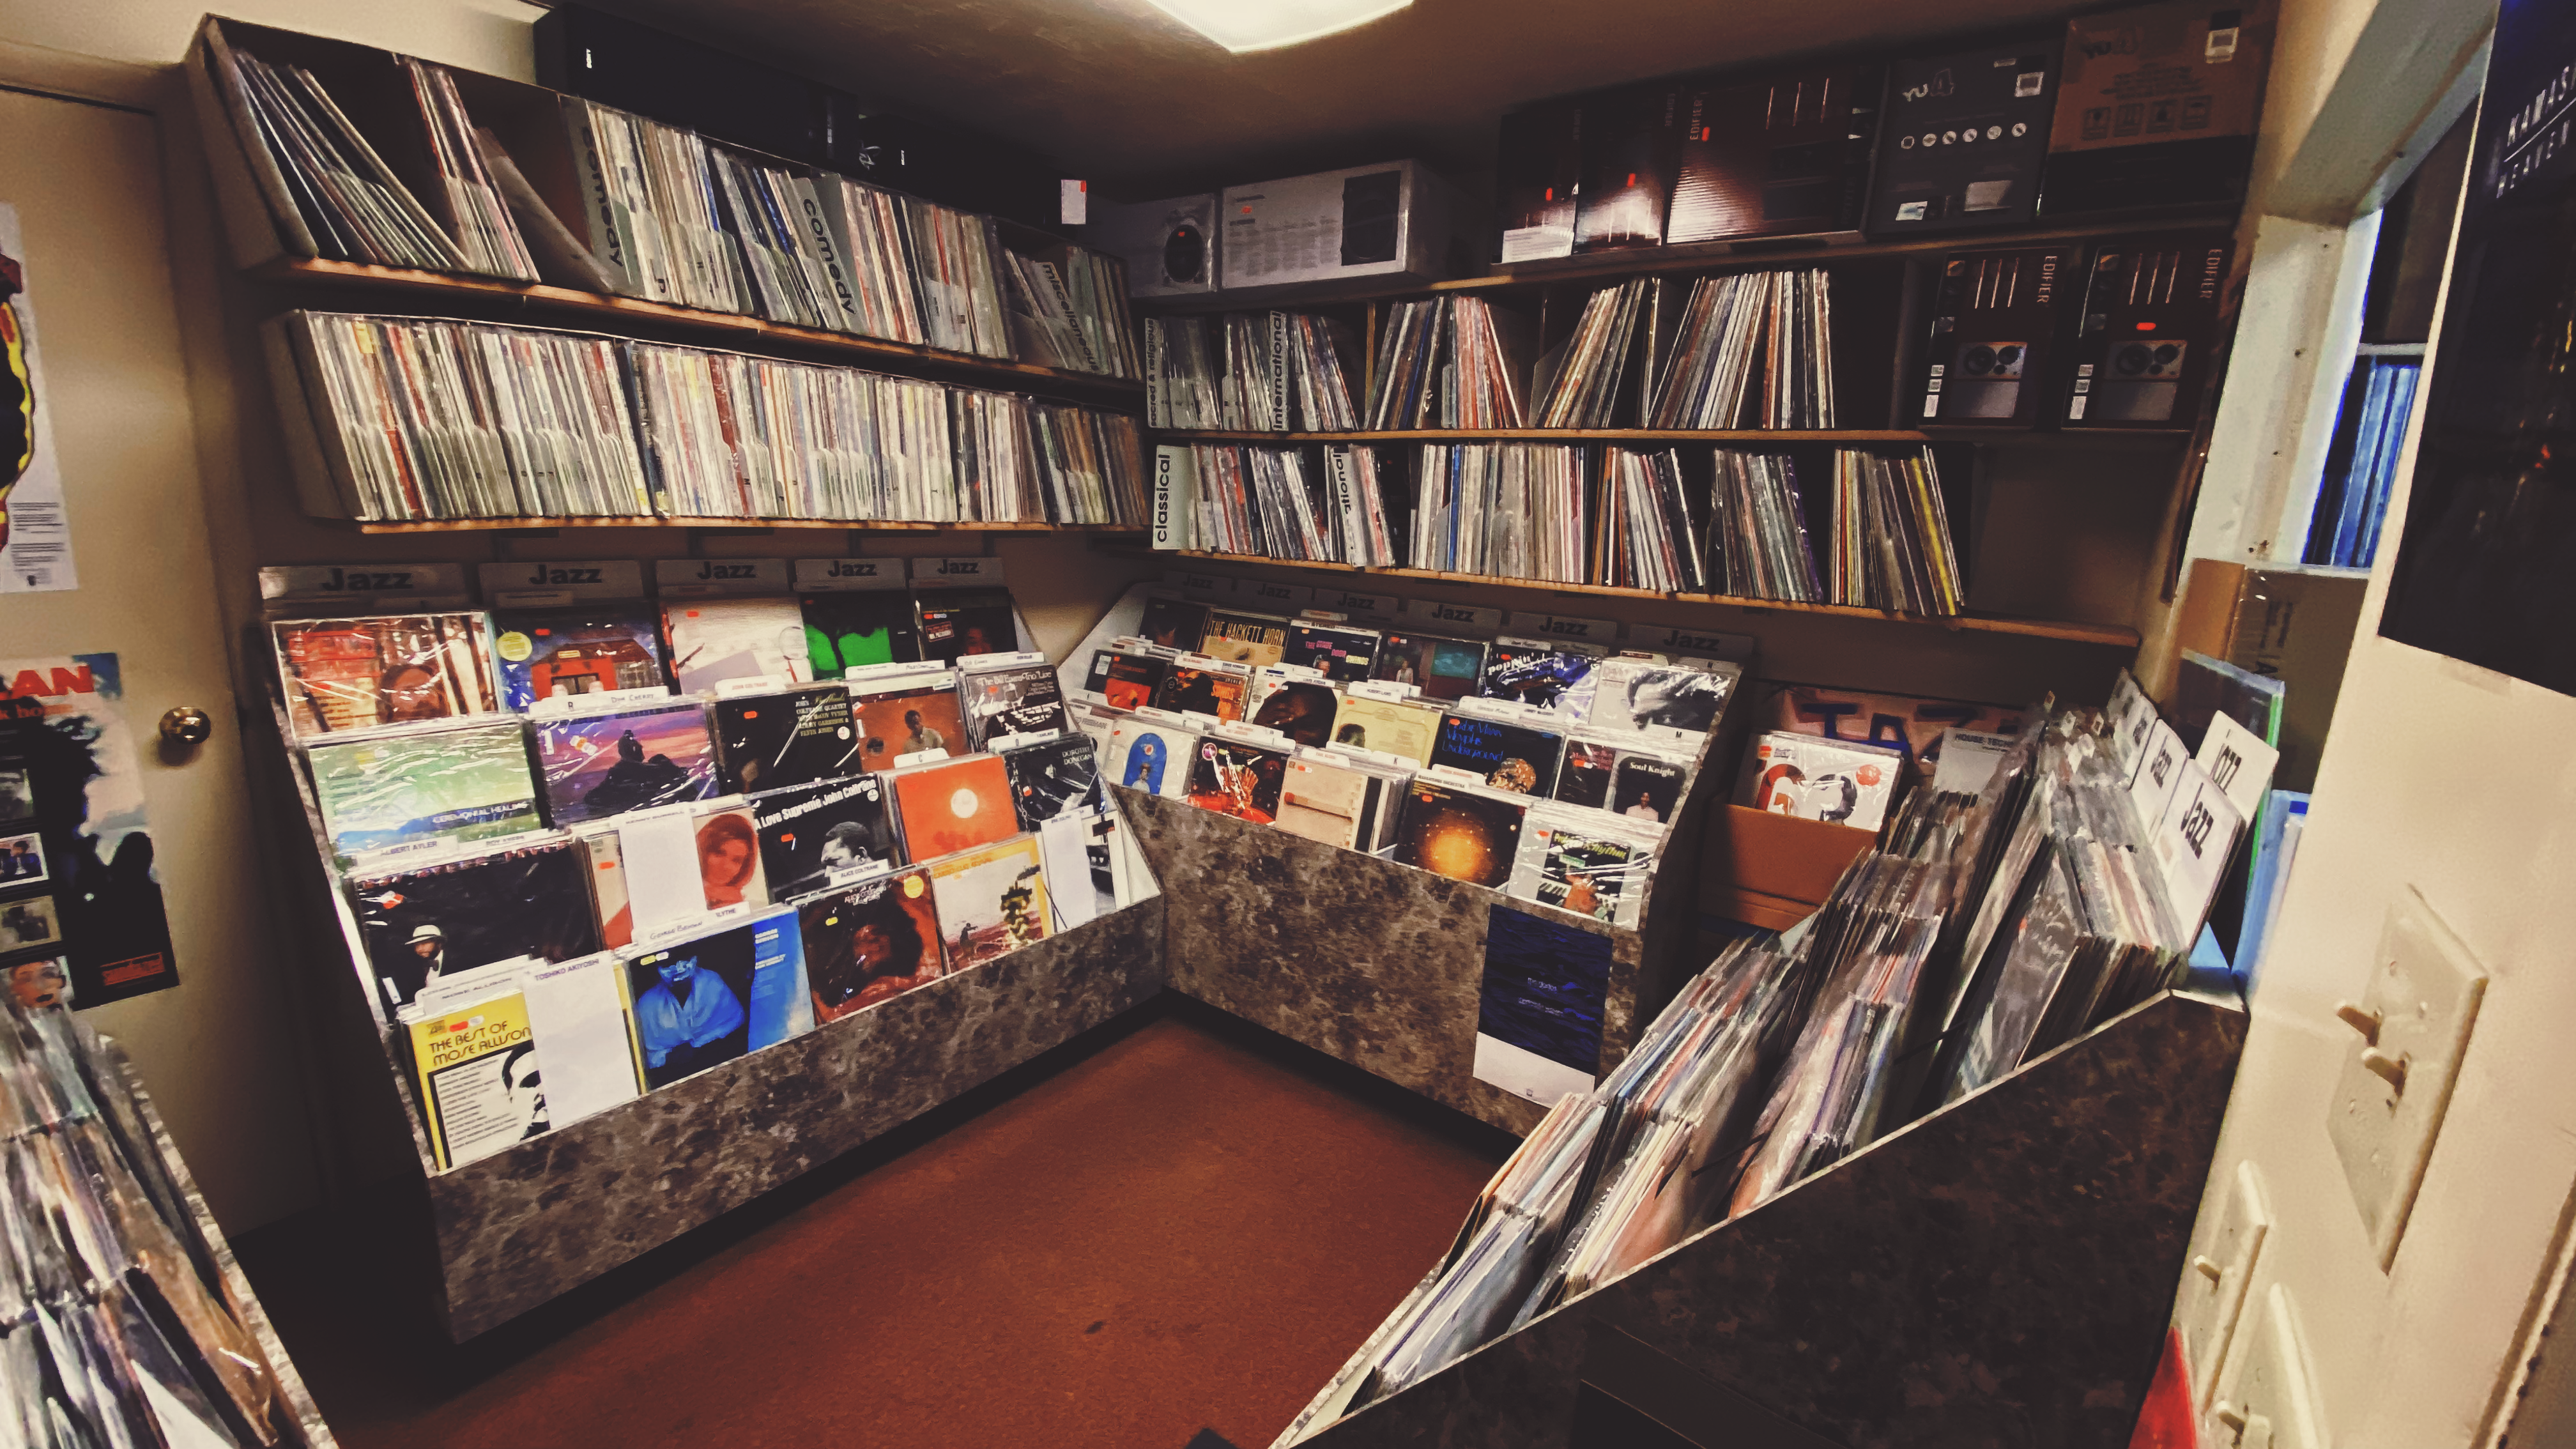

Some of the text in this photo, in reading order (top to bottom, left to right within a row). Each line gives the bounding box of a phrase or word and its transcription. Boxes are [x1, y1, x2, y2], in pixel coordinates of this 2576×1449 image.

[582, 126, 624, 267] comedy
[803, 198, 857, 314] comedy
[2037, 256, 2058, 303] EDIFIER
[2200, 249, 2223, 298] EDIFIER
[1042, 264, 1100, 372] miscellaneous
[1333, 452, 1353, 516] ational
[529, 564, 602, 584] Jazz
[697, 560, 756, 580] Jazz
[827, 560, 878, 578] Jazz
[937, 559, 979, 575] Jazz
[322, 567, 414, 591] Jazz
[1182, 574, 1214, 589] Jazz
[1257, 583, 1291, 599] Jazz
[1337, 593, 1376, 610] Jazz
[1431, 604, 1475, 623] Jazz
[1210, 620, 1225, 638] THE
[1226, 622, 1262, 643] HACKETT
[1262, 627, 1287, 647] HORN
[1538, 616, 1588, 636] Jazz
[1664, 630, 1720, 652] Jazz
[1629, 761, 1676, 778] Soul Knight
[755, 779, 877, 830] A Love Supreme John Coltrane
[2181, 782, 2214, 860] Jazz
[841, 864, 879, 878] ALICE COLTRANE
[534, 958, 599, 981] TOSHIKO AKIYOSHI
[429, 1036, 452, 1054] THE
[455, 1027, 486, 1046] BEST
[489, 1020, 509, 1034] OF
[433, 1026, 533, 1066] MOSE ALLISON
